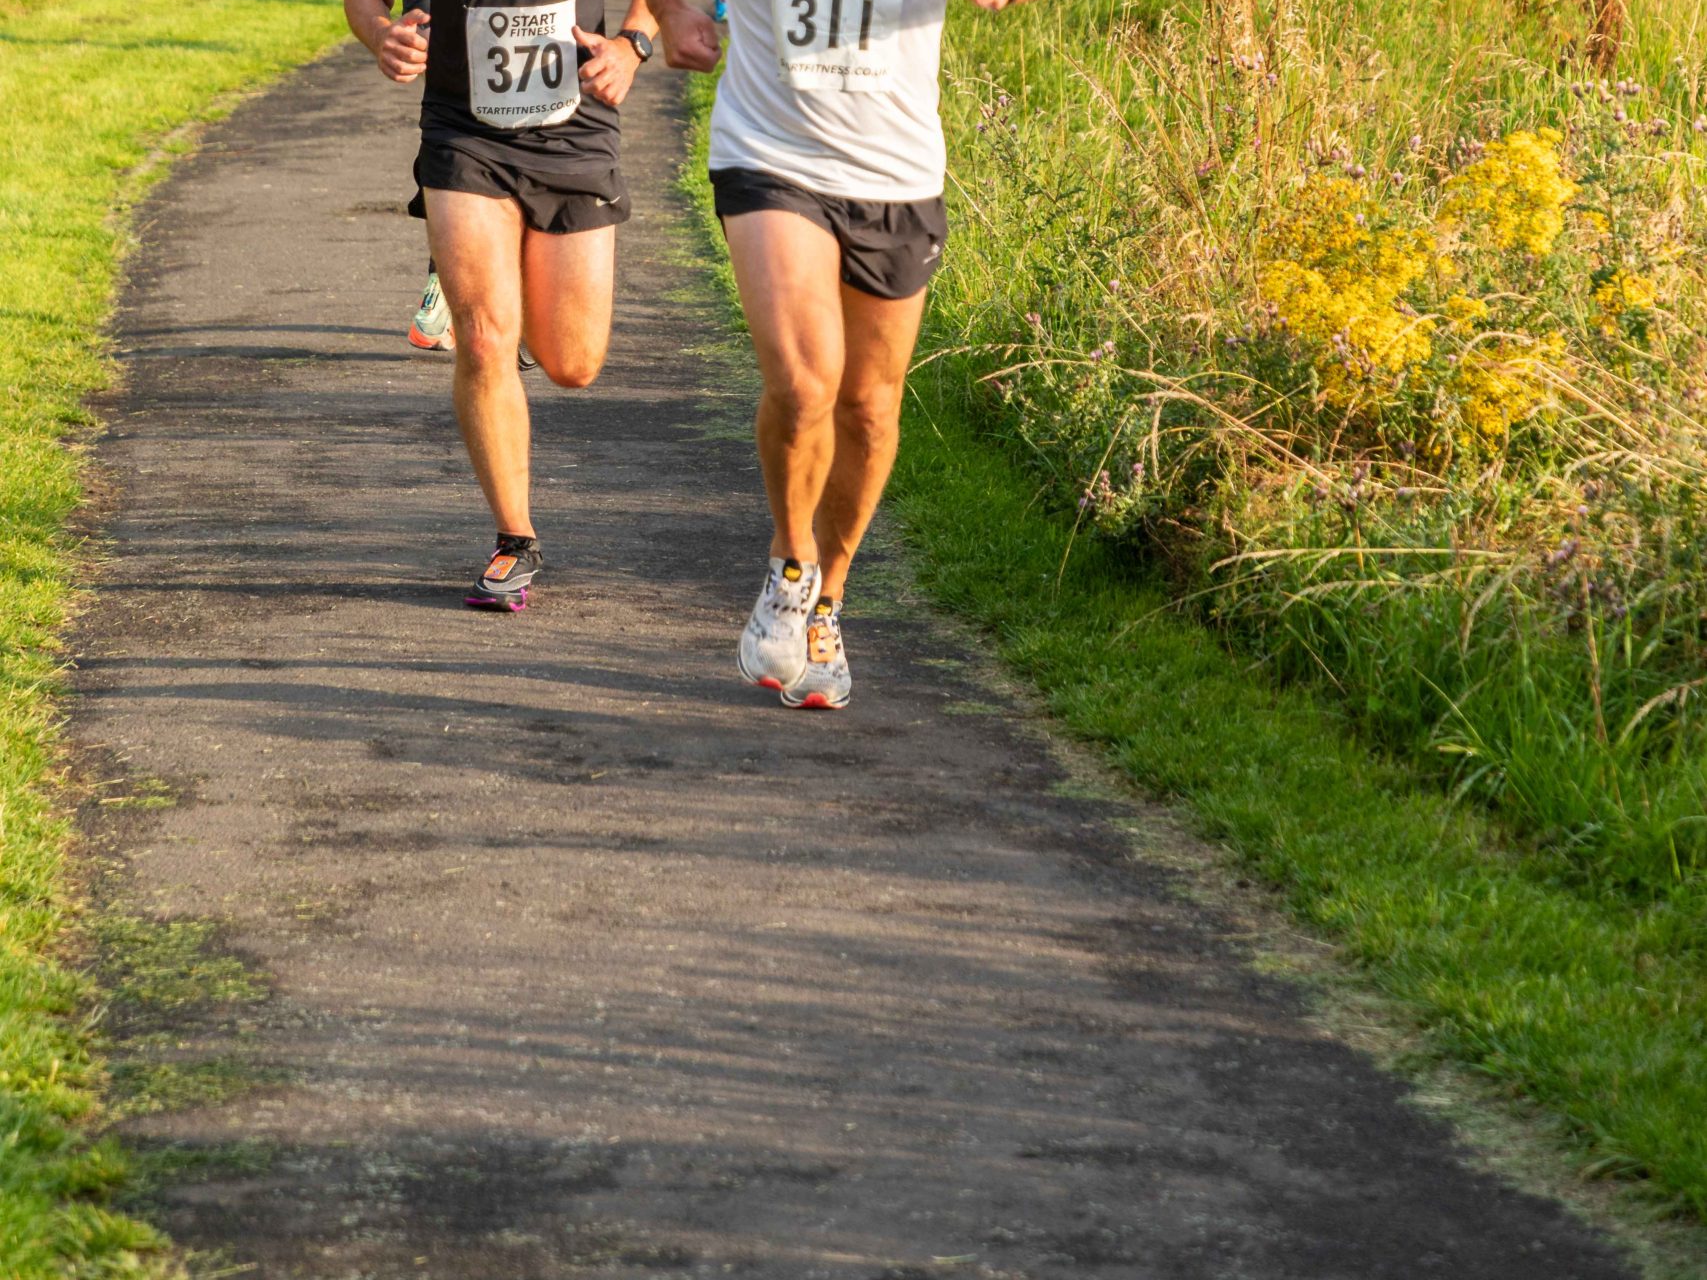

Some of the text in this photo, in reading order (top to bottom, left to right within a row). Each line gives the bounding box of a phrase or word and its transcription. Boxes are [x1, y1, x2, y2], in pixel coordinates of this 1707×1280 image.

[511, 12, 557, 28] START
[510, 25, 556, 38] FITNESS
[487, 42, 563, 94] 370
[476, 98, 577, 116] STARTFITNESS.CO.UK
